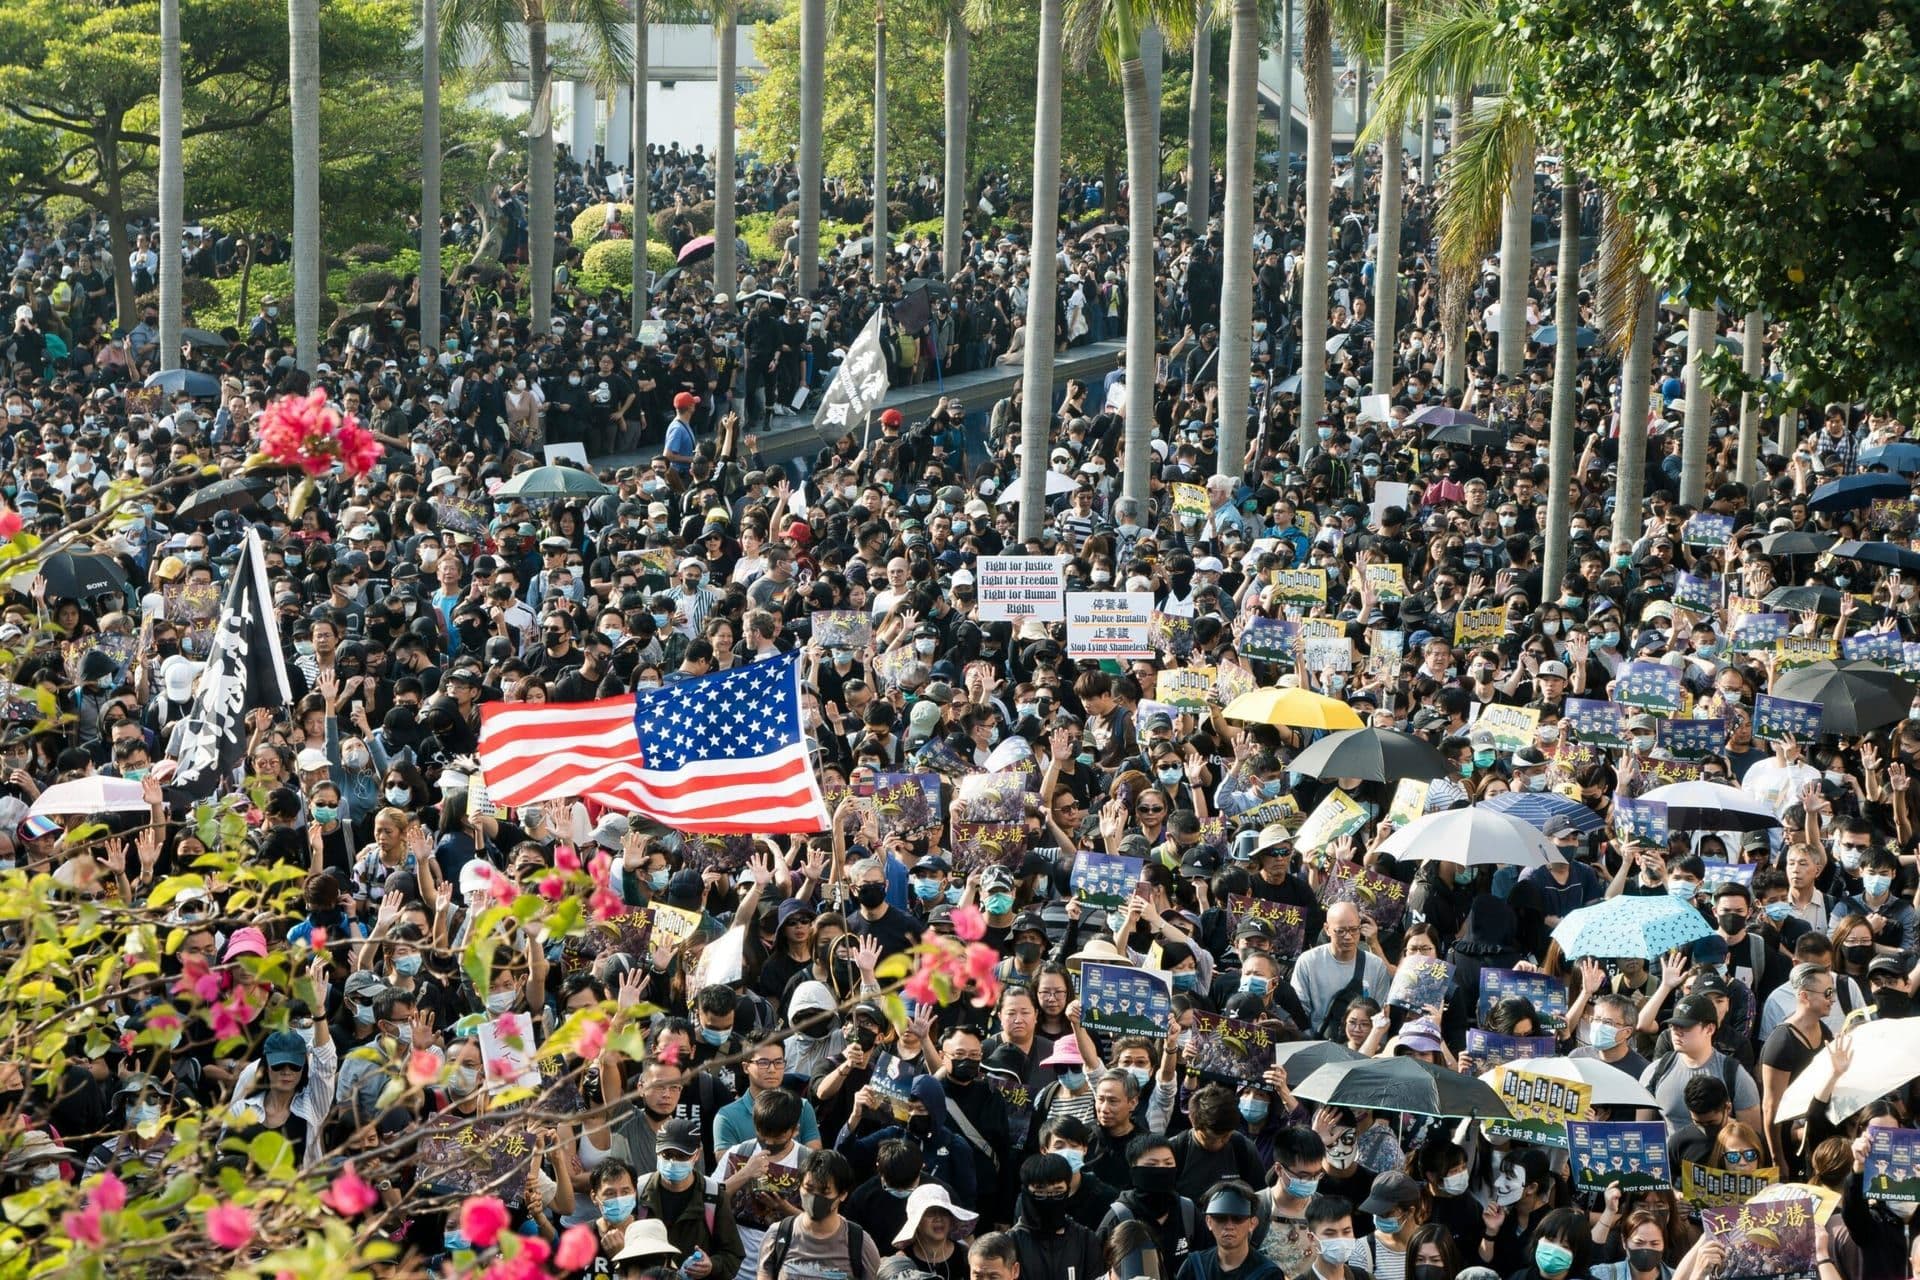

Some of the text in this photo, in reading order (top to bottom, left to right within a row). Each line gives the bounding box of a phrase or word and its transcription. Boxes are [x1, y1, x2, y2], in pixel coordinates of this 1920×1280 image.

[985, 560, 1053, 572] Fight for Justice
[86, 581, 108, 591] SONY
[981, 574, 1058, 586] Fight for Freedom
[984, 589, 1056, 600] Fight for Human
[1006, 603, 1035, 614] Rights
[1074, 614, 1147, 623] Stop Police Brutality
[1071, 642, 1087, 651] Stop
[1088, 642, 1107, 651] Lying
[957, 826, 1026, 844] 正義必勝
[1337, 865, 1406, 900] 正義必勝
[1231, 900, 1304, 927] 正義必勝
[1093, 1023, 1122, 1033] DEMANDS
[1126, 1027, 1139, 1036] NOT
[1140, 1029, 1153, 1037] ONE
[1153, 1030, 1168, 1039] LESS
[1199, 1016, 1274, 1048] 正義必勝
[1491, 1125, 1533, 1140] 五大訴求
[1655, 1183, 1670, 1191] LESS
[1866, 1191, 1916, 1201] FIVE DEMANDS
[1713, 1202, 1812, 1236] 正義必勝
